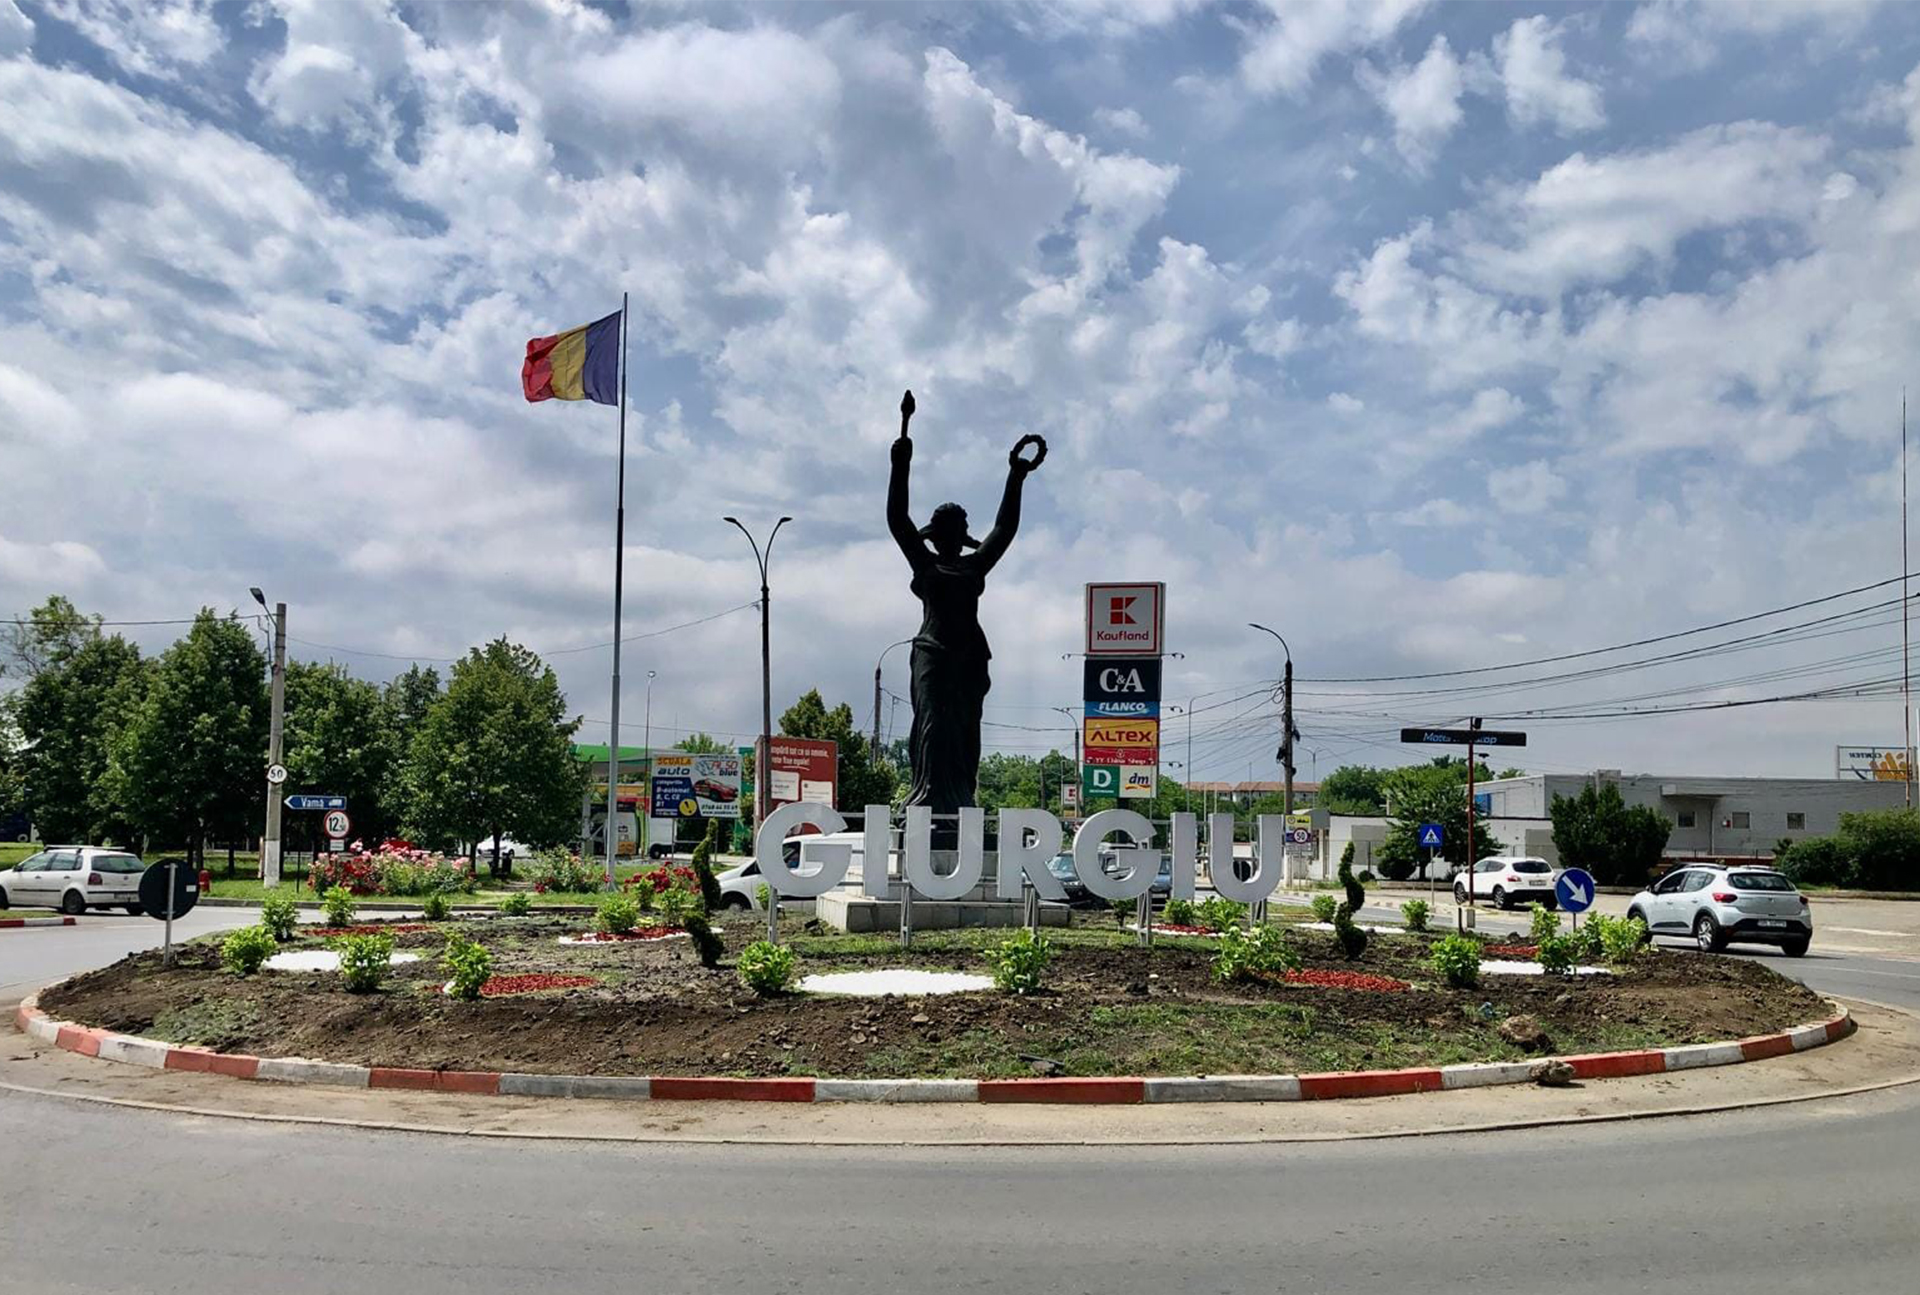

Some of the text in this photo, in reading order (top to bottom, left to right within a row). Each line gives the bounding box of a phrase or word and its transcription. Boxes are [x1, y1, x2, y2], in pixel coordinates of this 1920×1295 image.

[1097, 631, 1149, 642] Kaufland
[1099, 668, 1145, 693] C&A
[1099, 702, 1146, 712] FLANCO
[270, 769, 284, 778] 50
[658, 766, 691, 775] auto
[719, 768, 738, 776] blue
[1093, 769, 1111, 788] D
[1129, 773, 1149, 785] dm
[1297, 832, 1306, 841] 50
[755, 802, 1285, 901] GIURGIU
